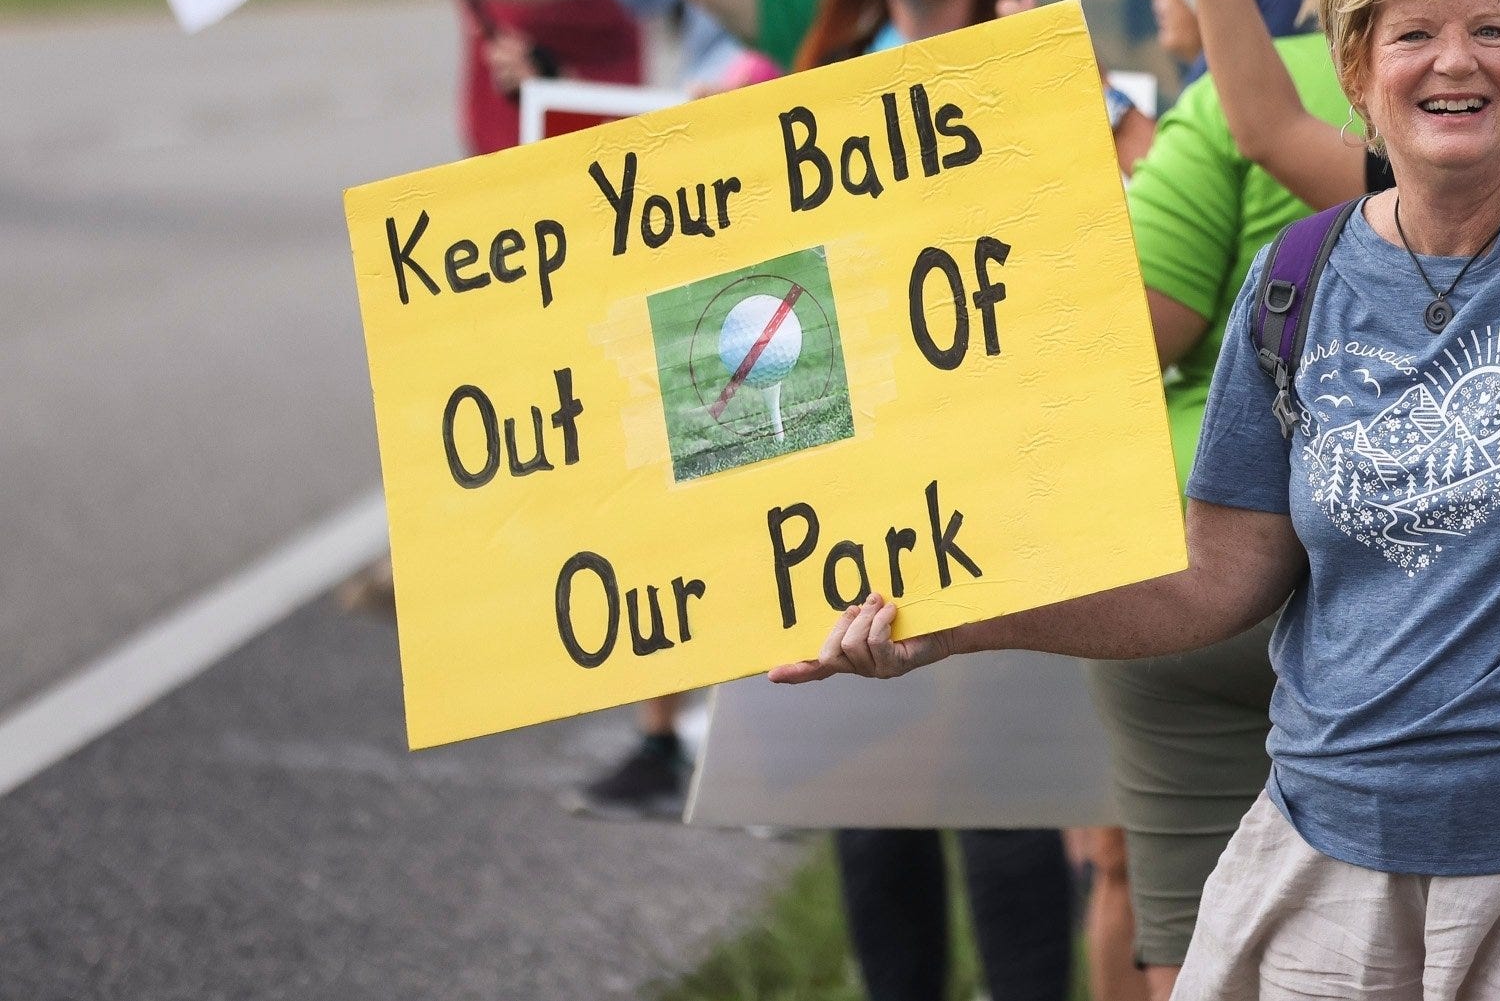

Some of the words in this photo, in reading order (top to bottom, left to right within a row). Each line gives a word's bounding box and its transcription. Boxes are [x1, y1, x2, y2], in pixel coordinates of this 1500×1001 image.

[385, 210, 567, 308] Keep
[588, 152, 742, 256] Your
[778, 83, 982, 213] Balls
[442, 367, 584, 490] Out
[908, 235, 1012, 371] Of
[554, 551, 706, 669] Our
[767, 480, 983, 629] Park
